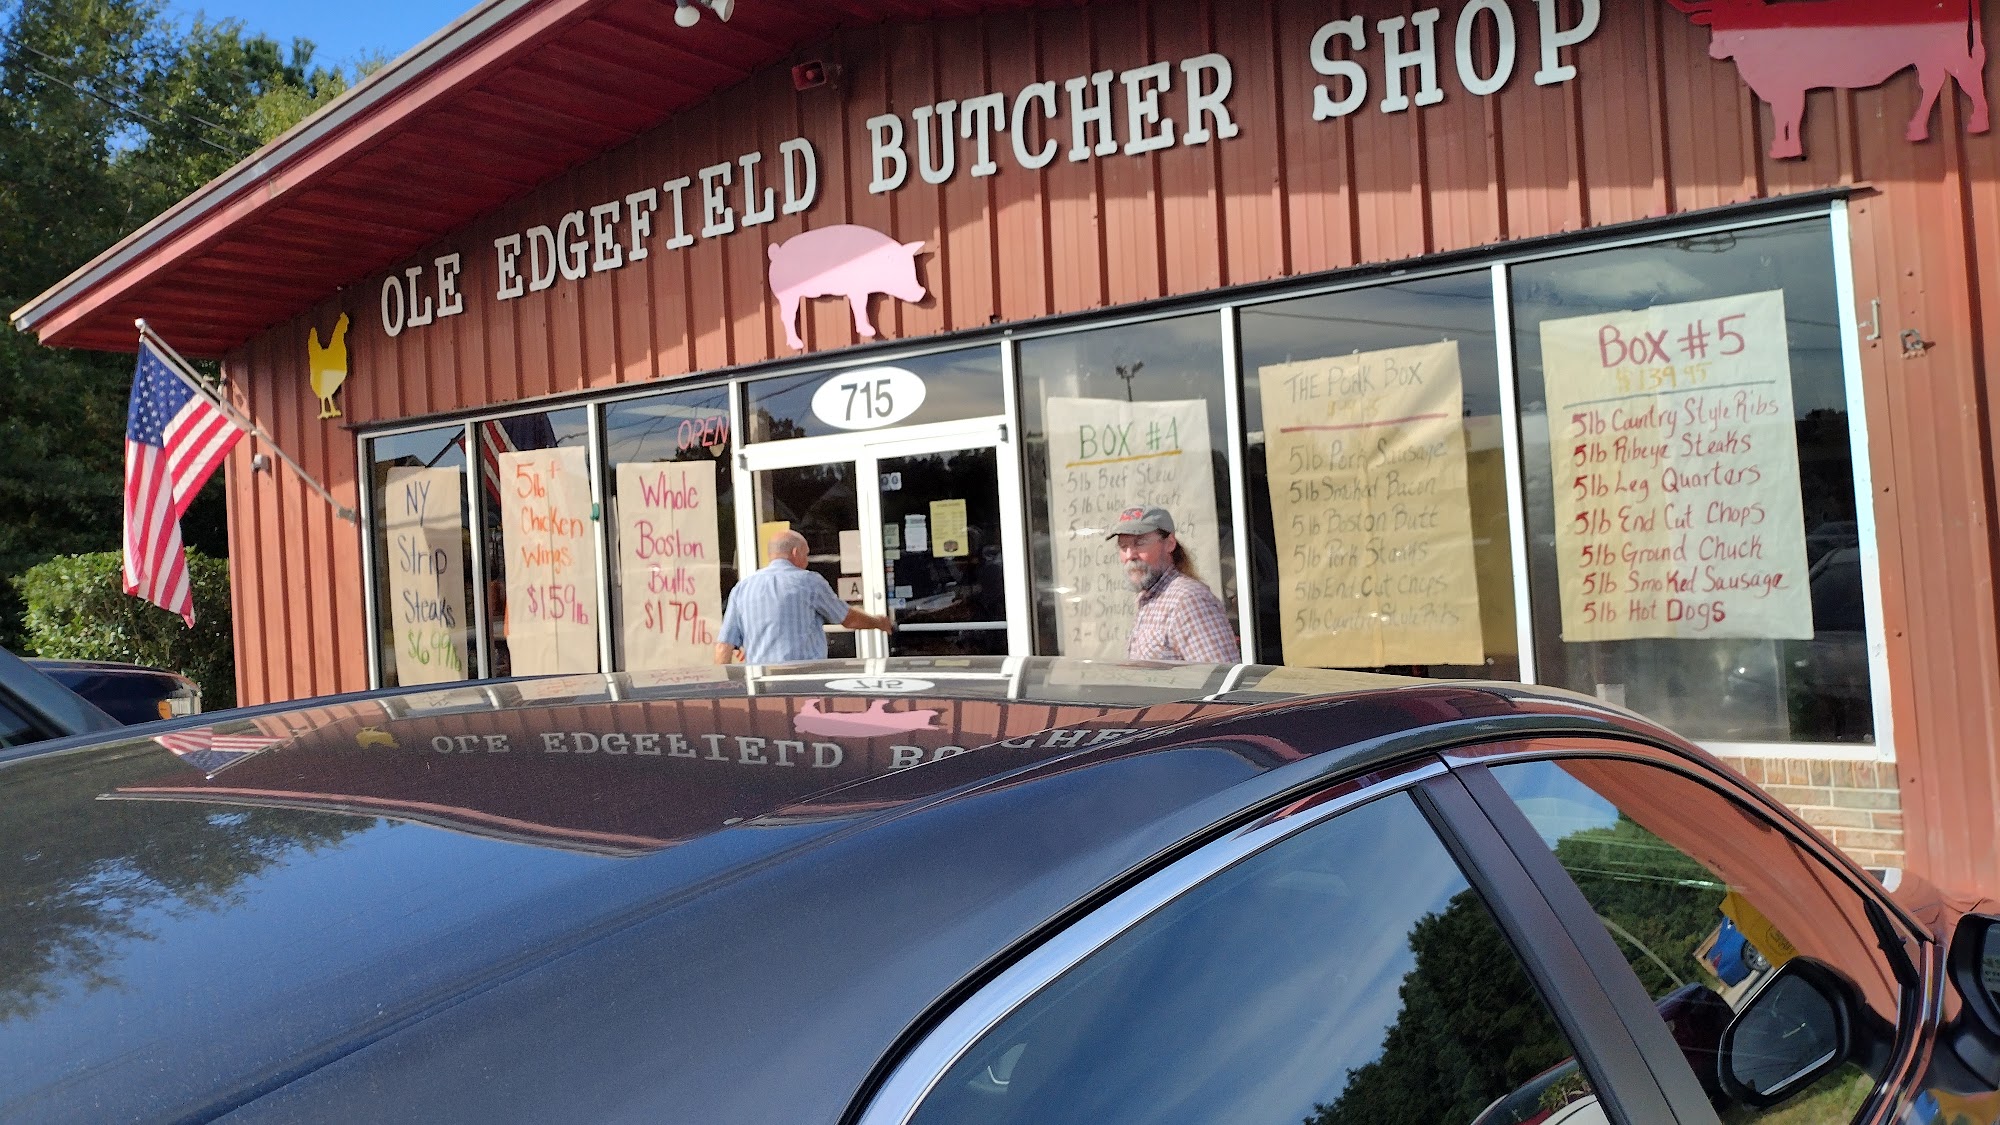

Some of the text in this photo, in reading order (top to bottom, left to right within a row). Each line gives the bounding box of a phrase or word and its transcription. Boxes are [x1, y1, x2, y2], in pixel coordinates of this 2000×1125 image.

[381, 0, 1602, 337] OLE EDGEFIELD BUTCHER SHOP
[841, 379, 894, 421] 715
[1283, 371, 1321, 403] THE
[1683, 395, 1730, 433] Style
[1734, 389, 1779, 424] Ribs
[677, 416, 730, 450] OPEN
[1079, 421, 1133, 459] BOX
[1612, 436, 1670, 469] Ribeye
[638, 471, 699, 509] Whole
[1098, 466, 1129, 488] Beef
[1136, 462, 1177, 486] Stew
[1614, 472, 1650, 502] Leg
[1661, 460, 1761, 494] Quarters
[406, 480, 431, 527] NY
[1392, 503, 1440, 531] Butt
[1617, 505, 1656, 535] End
[1664, 503, 1694, 531] Cut
[1706, 501, 1766, 529] Chops
[521, 505, 584, 539] Chicken
[635, 520, 705, 560] Boston
[1622, 534, 1687, 565] Ground
[1699, 534, 1763, 562] Chuck
[397, 534, 448, 597] Strip
[521, 543, 573, 574] Wings
[1703, 564, 1789, 597] Sausage
[403, 587, 456, 629] Steaks
[1629, 598, 1657, 622] Hot
[1666, 598, 1727, 631] Dogs
